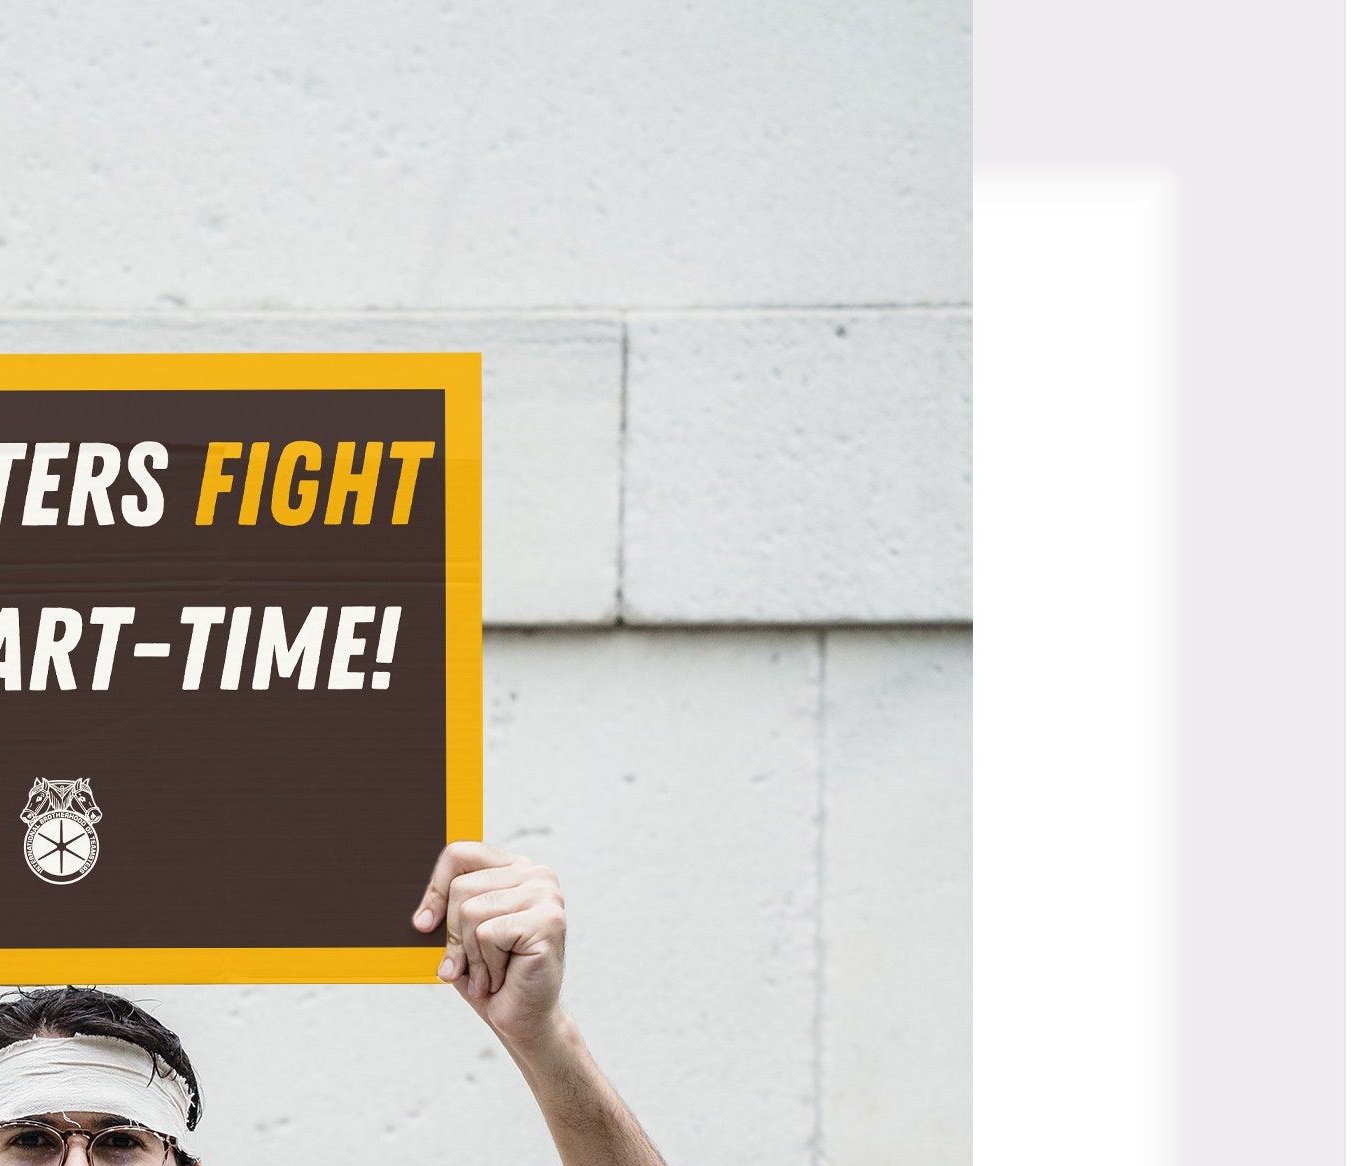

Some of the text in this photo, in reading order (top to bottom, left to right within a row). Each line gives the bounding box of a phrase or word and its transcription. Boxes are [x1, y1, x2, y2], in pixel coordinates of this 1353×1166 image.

[195, 441, 435, 526] FIGHT
[27, 824, 43, 873] INTERNATIONAL
[40, 812, 87, 827] BROTHERHOOD
[80, 835, 97, 873] TEAMSTERS
